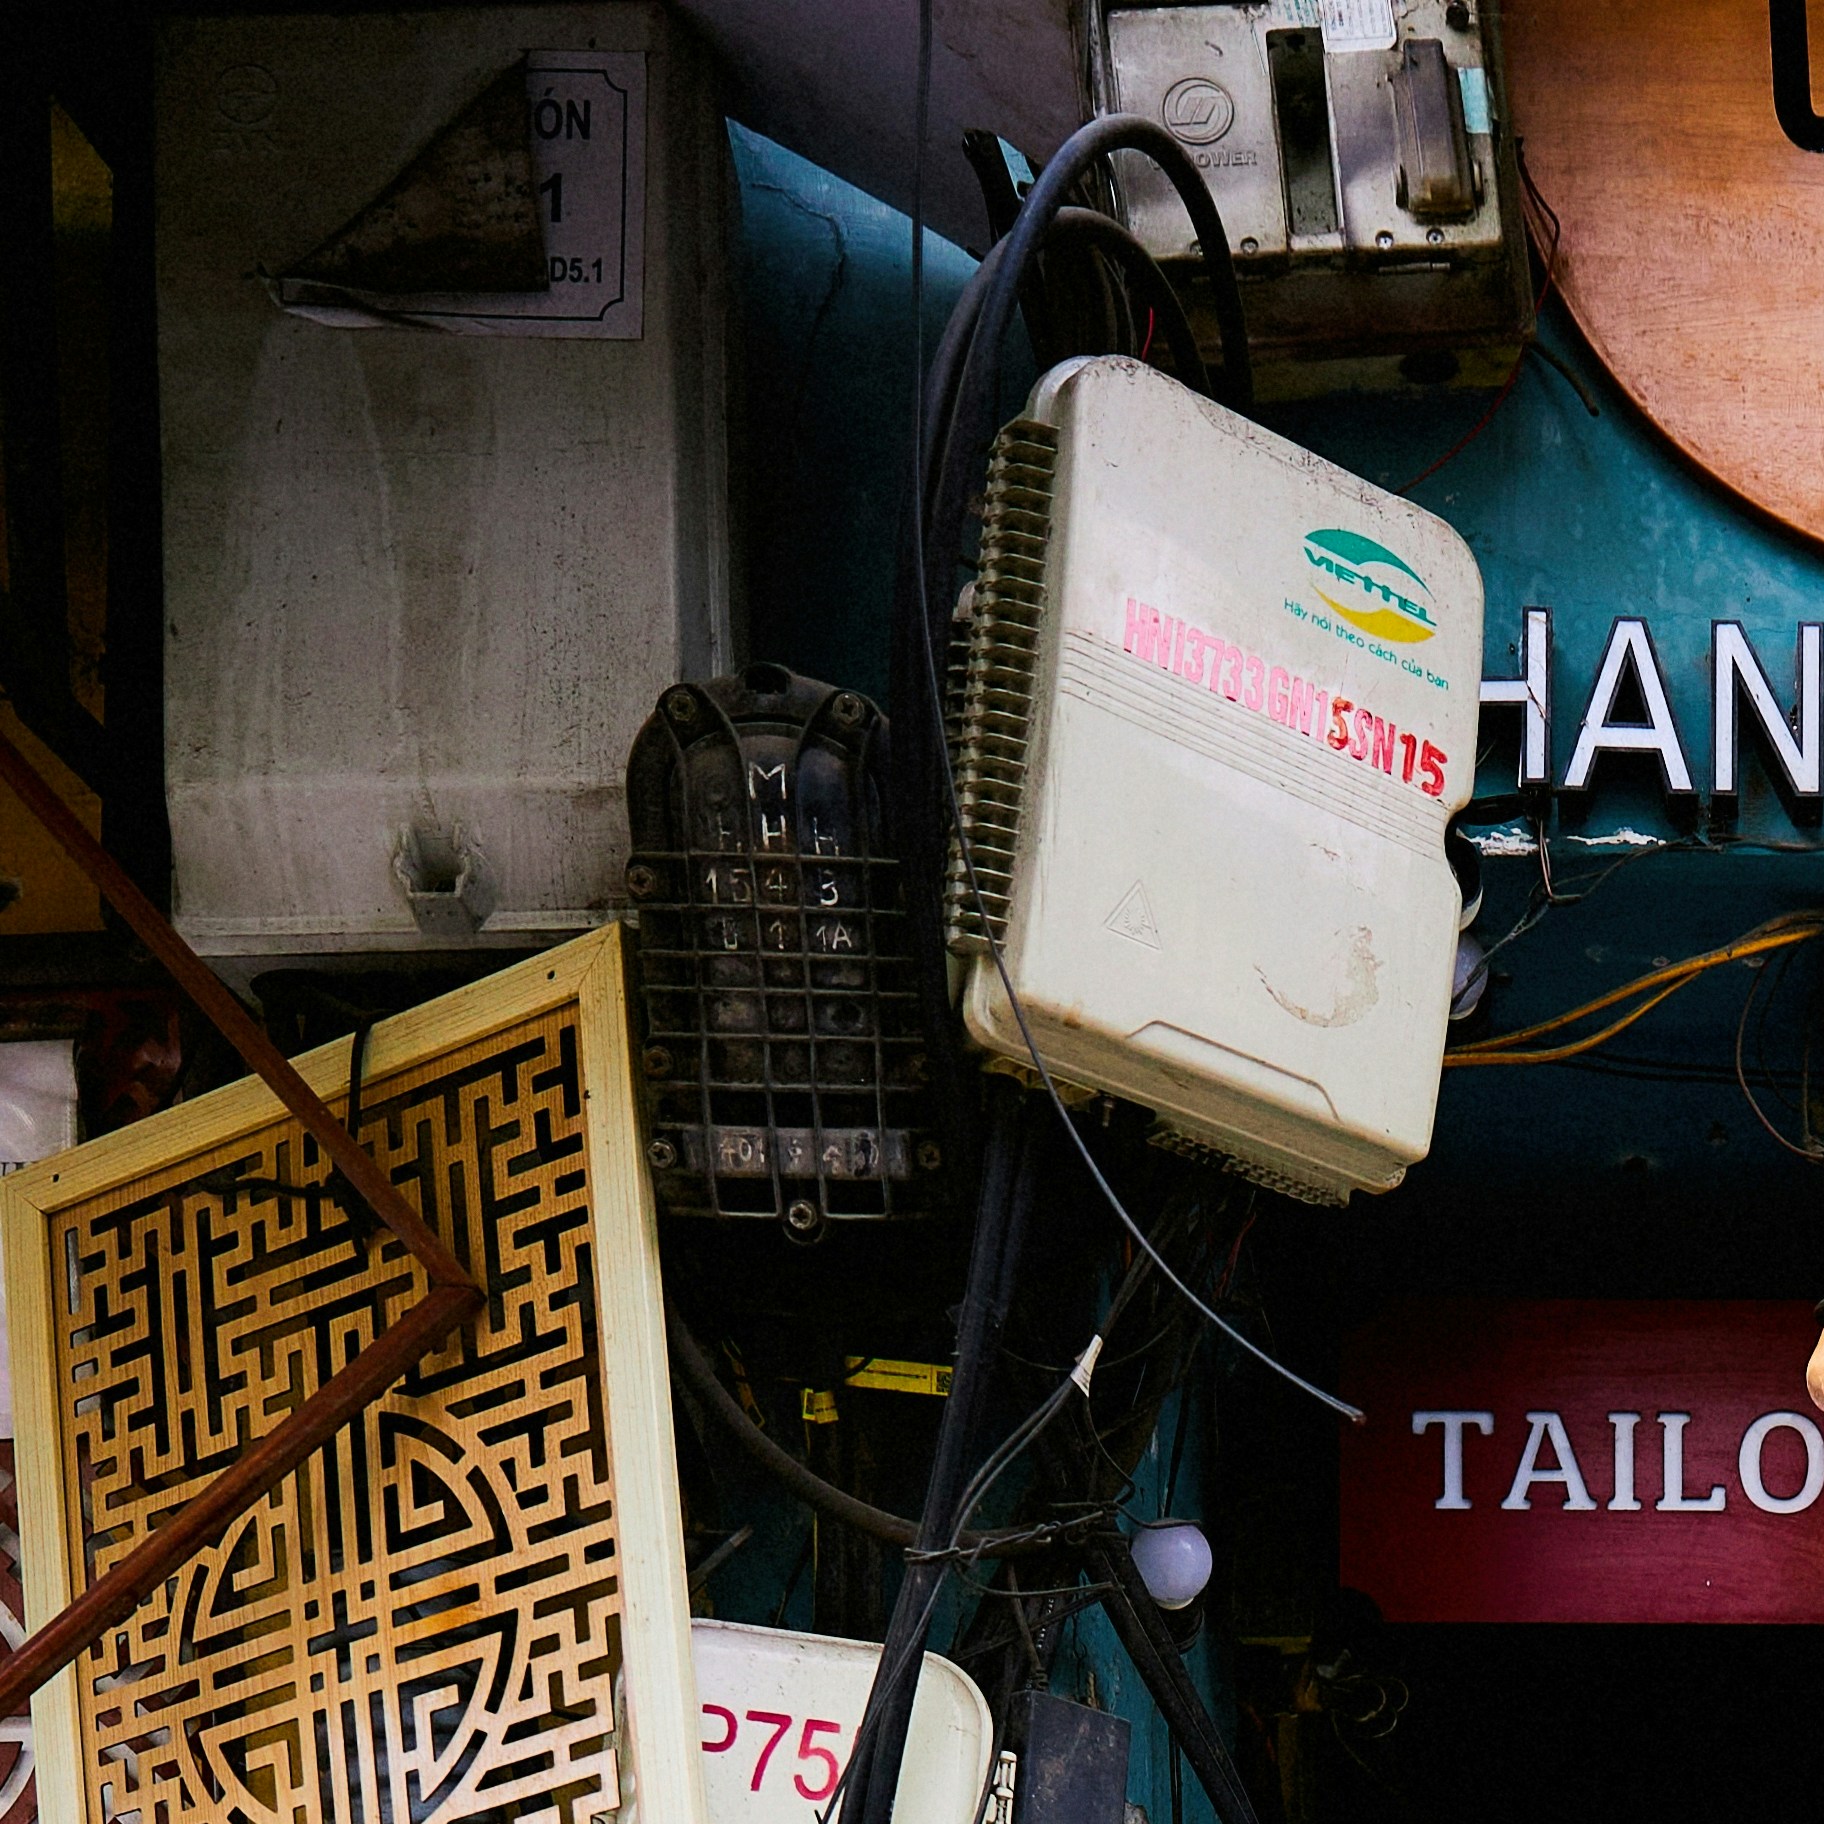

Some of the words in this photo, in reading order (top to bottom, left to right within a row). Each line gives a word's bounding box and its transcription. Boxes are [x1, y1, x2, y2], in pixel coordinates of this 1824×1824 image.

[1303, 546, 1437, 627] VIETTEL
[1284, 597, 1308, 620] Hãy
[1312, 614, 1332, 632] nói
[1336, 624, 1365, 648] theo
[1368, 642, 1397, 665] cách
[1401, 658, 1423, 678] của
[1427, 668, 1449, 690] bạn
[702, 1703, 861, 1802] P75
